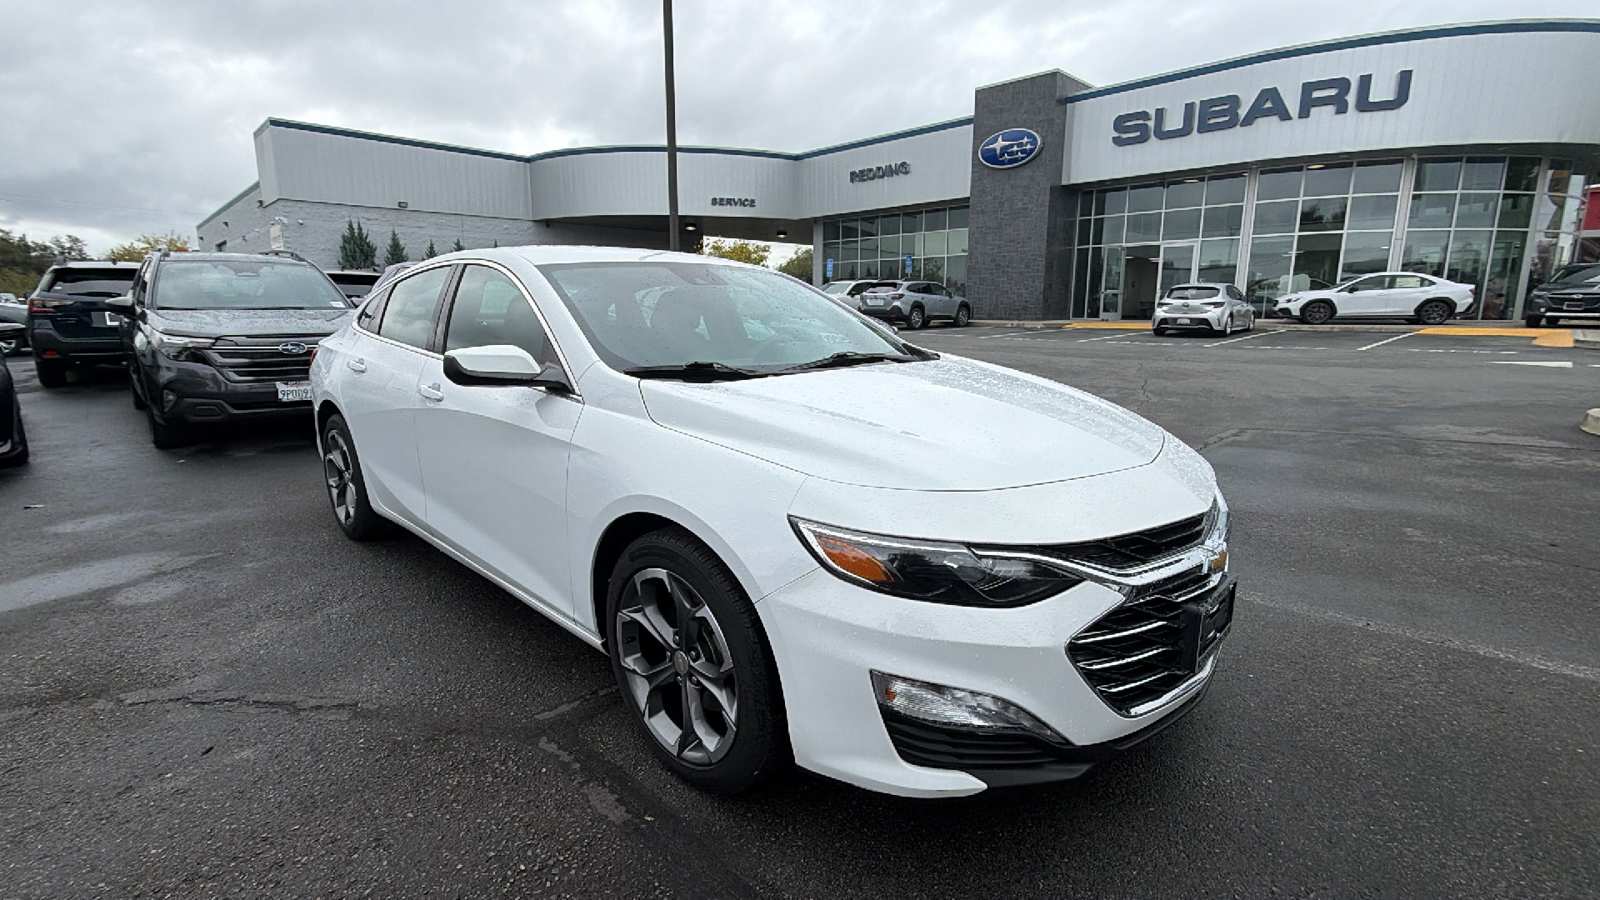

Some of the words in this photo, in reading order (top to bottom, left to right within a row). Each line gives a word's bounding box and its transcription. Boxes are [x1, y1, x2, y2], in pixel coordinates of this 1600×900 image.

[1112, 69, 1413, 147] SUBARU
[849, 161, 911, 184] REDDING
[711, 197, 757, 208] SERVICE
